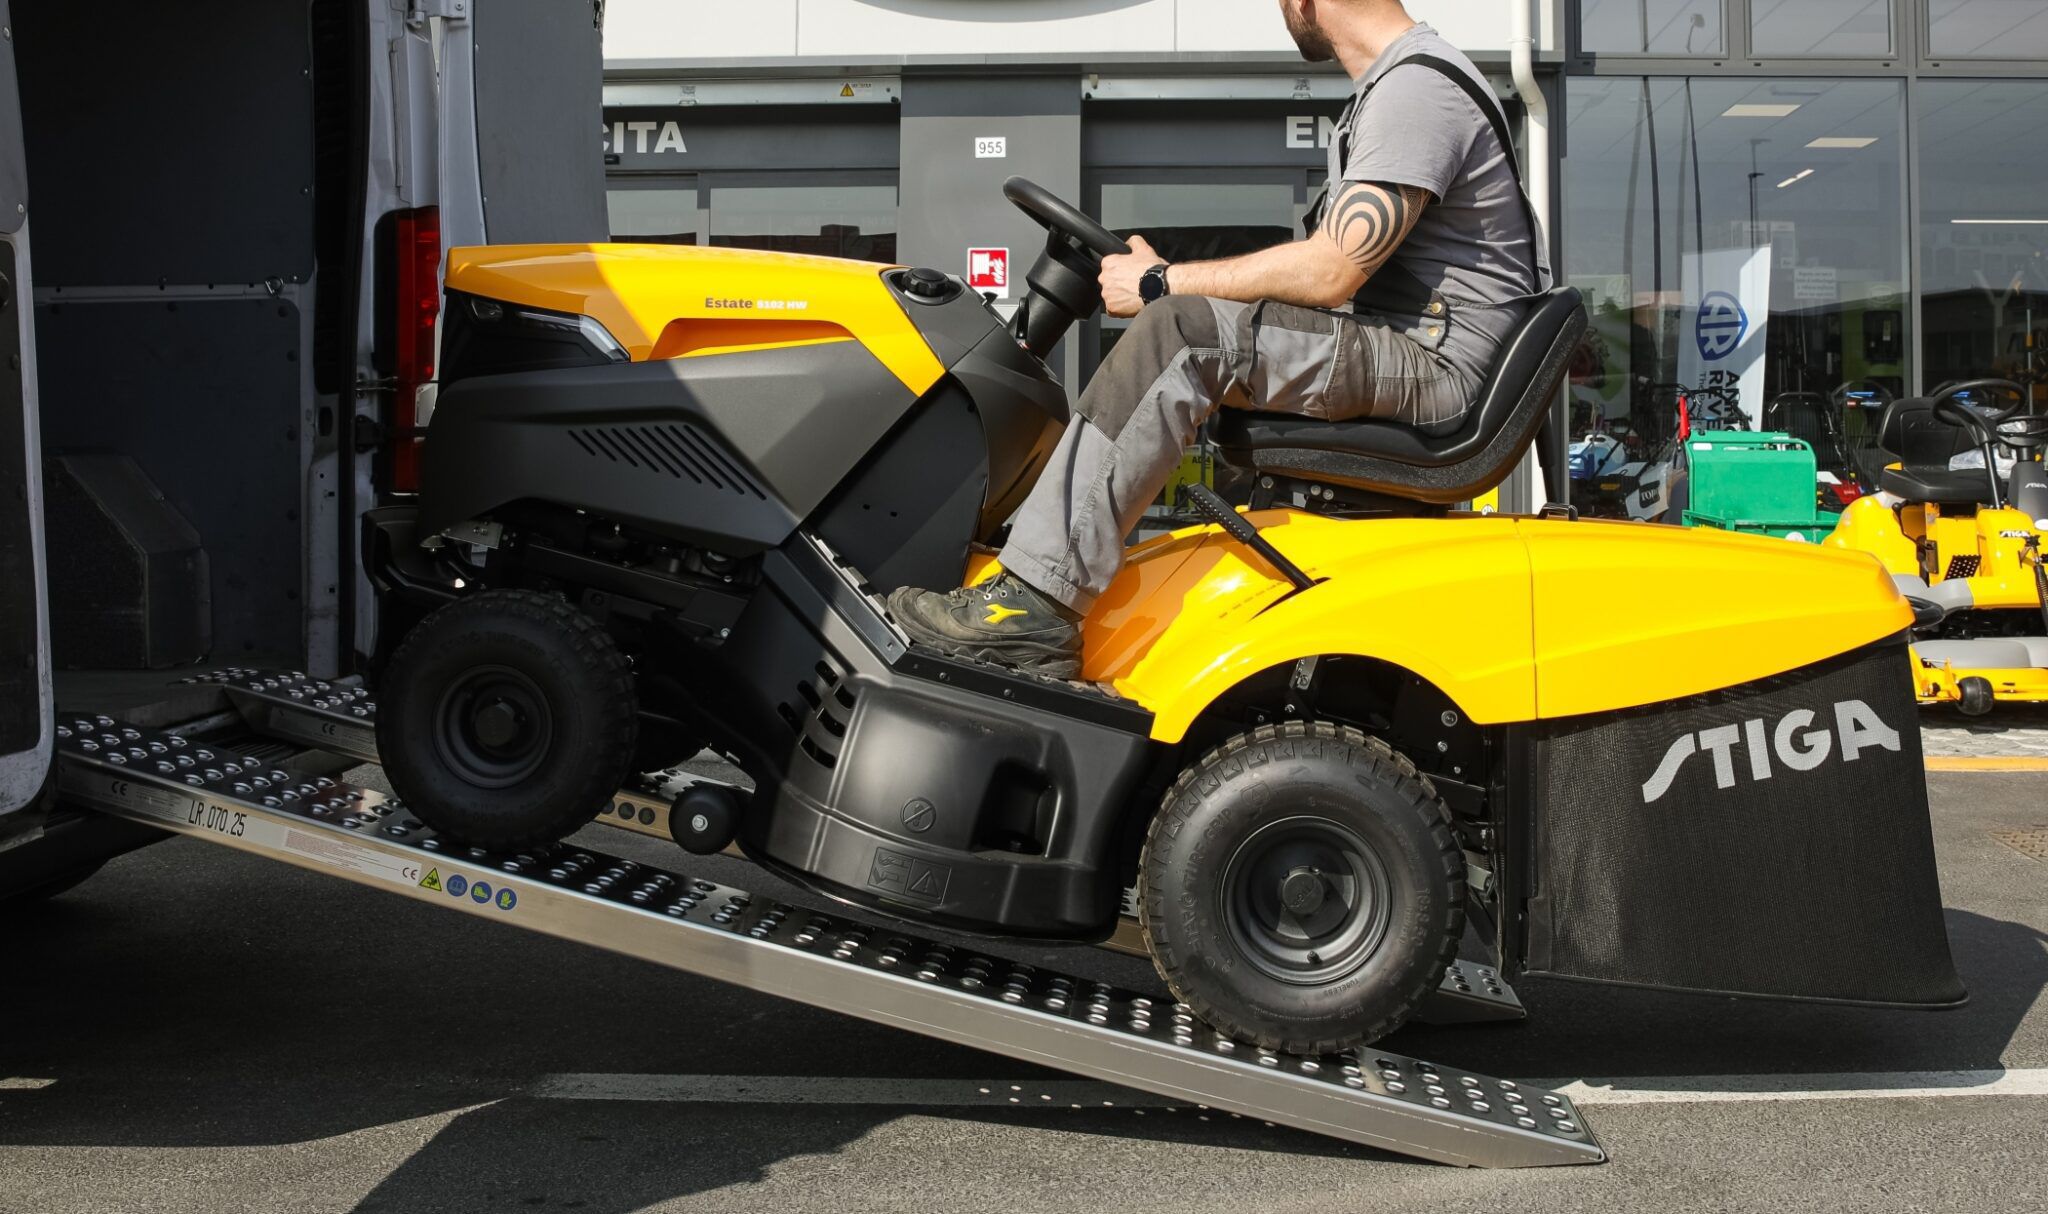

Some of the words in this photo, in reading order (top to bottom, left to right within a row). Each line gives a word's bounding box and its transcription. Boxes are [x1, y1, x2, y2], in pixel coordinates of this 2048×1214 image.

[602, 121, 687, 153] ITA
[979, 141, 1003, 154] 955
[705, 297, 753, 309] Estate
[787, 300, 808, 310] HW
[2000, 530, 2030, 538] STIGA
[1641, 699, 1901, 803] STIGA
[402, 866, 418, 880] CE
